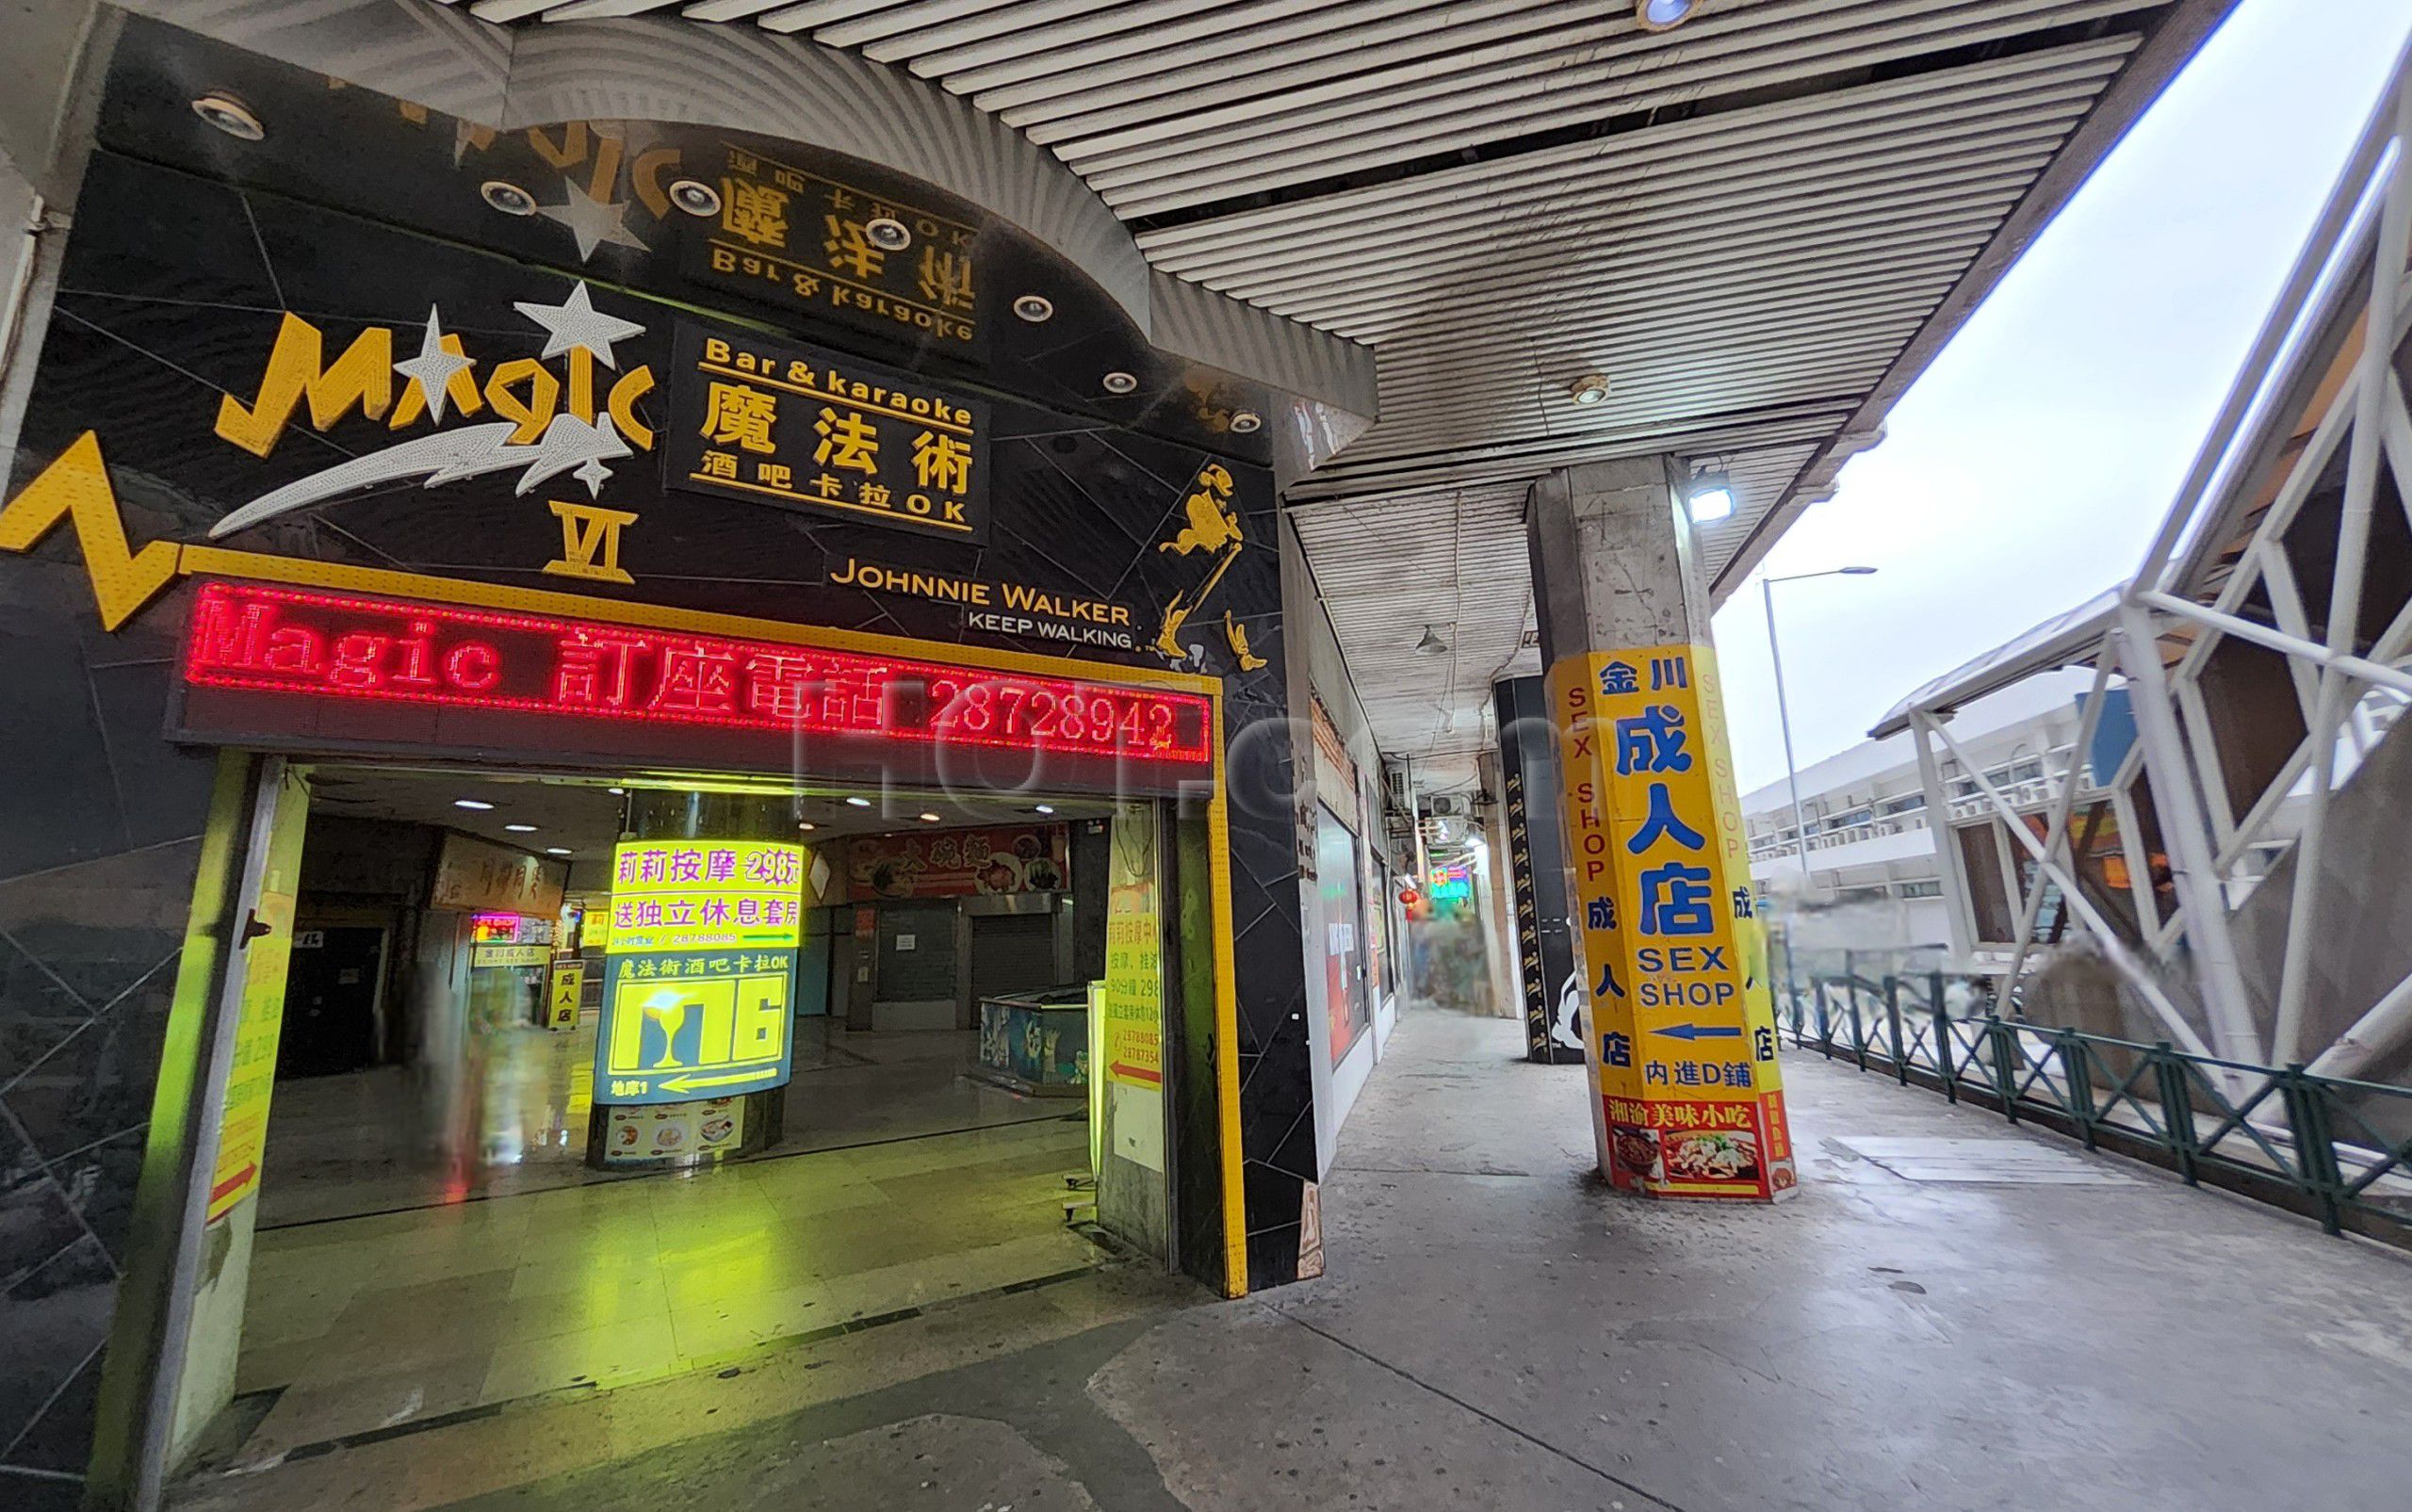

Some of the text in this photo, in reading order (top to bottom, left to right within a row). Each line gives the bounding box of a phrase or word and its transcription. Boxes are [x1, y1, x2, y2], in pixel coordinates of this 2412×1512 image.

[705, 336, 973, 426] Bar & karaoke
[699, 381, 974, 496] 魔法術
[543, 500, 639, 585] VI
[829, 558, 1131, 627] JOHNNIE WALKER
[969, 610, 1034, 637] KEEP
[199, 597, 1174, 751] Magic 訂座電話 28728942
[1599, 656, 1689, 695] 金川
[1568, 687, 1606, 883] SEX SHOP
[1615, 704, 1716, 935] 成人店
[618, 848, 737, 885] 莉莉按摩
[613, 898, 799, 929] 送独立休息套房
[1588, 896, 1632, 1068] 成人店
[1637, 946, 1730, 973] SEX
[1639, 982, 1736, 1008] SHOP
[1732, 886, 1775, 1063] 成店
